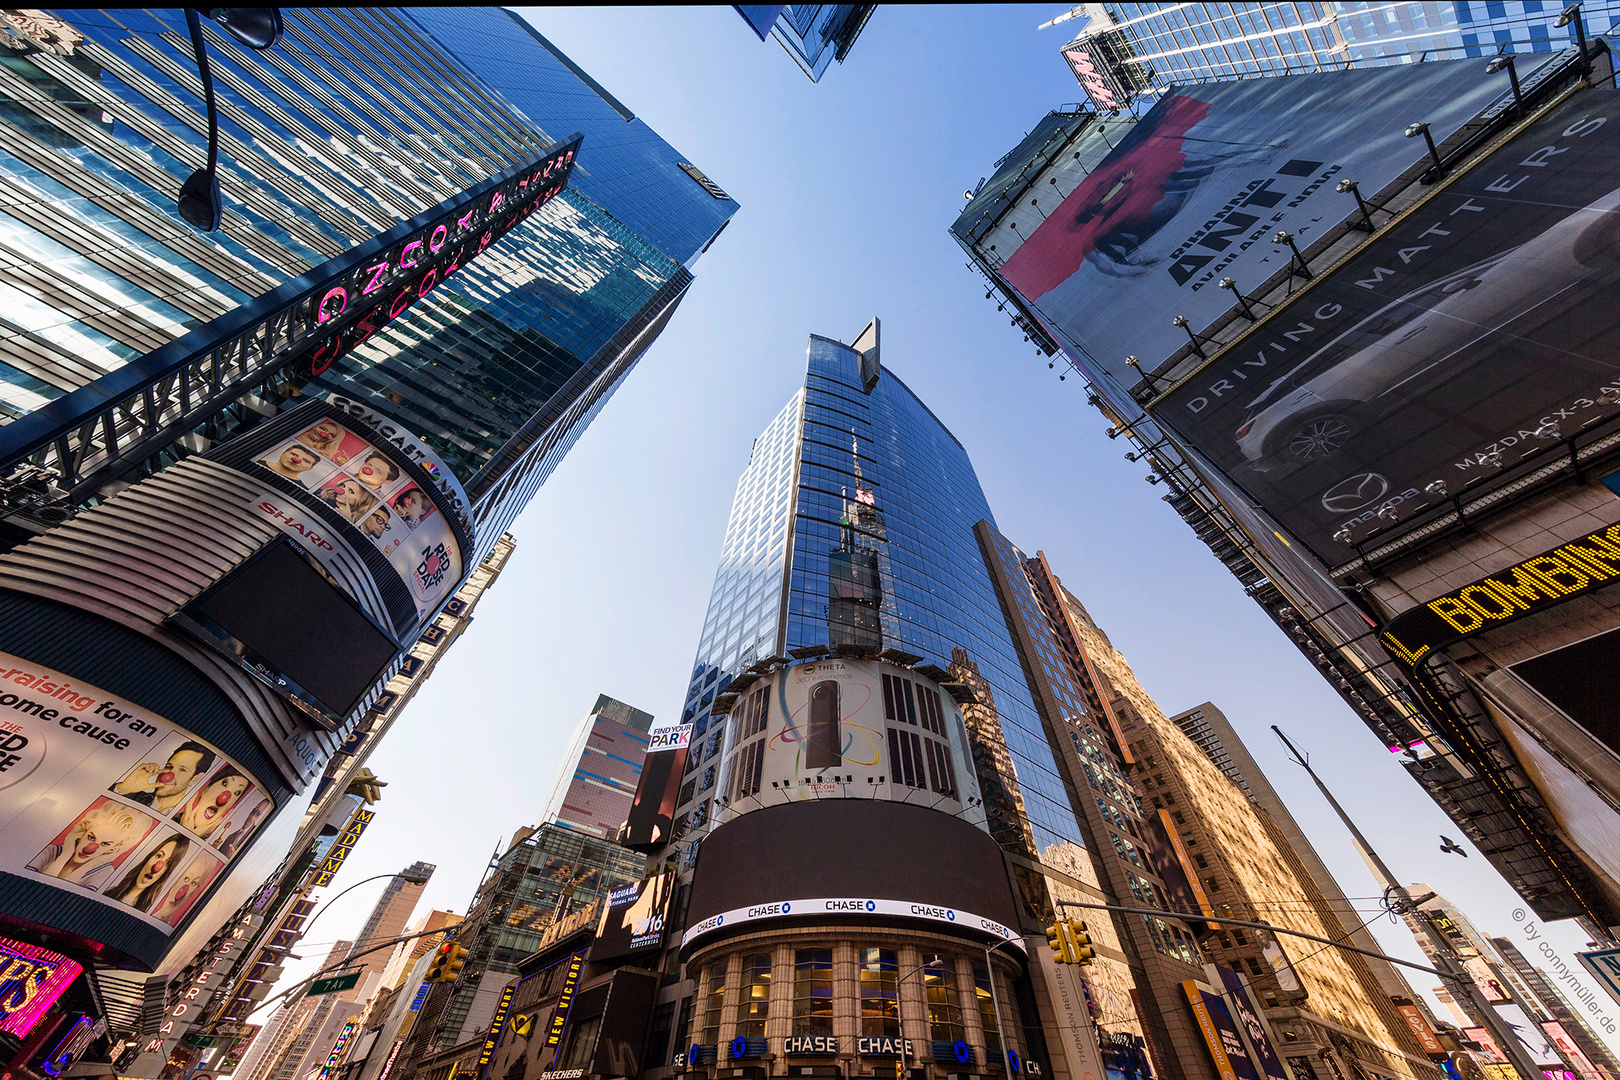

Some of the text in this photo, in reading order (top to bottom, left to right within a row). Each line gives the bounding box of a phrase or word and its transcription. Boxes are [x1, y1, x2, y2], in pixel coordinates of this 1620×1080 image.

[1167, 159, 1324, 287] ANTI
[1169, 178, 1264, 260] RIHANNA
[1191, 165, 1343, 292] AVAILABLE NOW
[1186, 114, 1608, 413] DRIVING MATTERS
[331, 396, 426, 463] COMCAST
[1455, 429, 1534, 471] MAZDA
[257, 501, 334, 553] SHARP
[434, 542, 451, 572] RED
[445, 545, 454, 557] THE
[413, 570, 426, 595] SPECIAL
[417, 560, 435, 590] DAY
[255, 662, 287, 688] SHARP
[818, 663, 846, 672] THETA
[0, 690, 131, 751] ome cause
[1, 721, 23, 734] THE
[94, 702, 133, 724] for
[129, 719, 157, 738] an
[653, 724, 691, 735] FIND YOUR
[288, 733, 317, 771] AQUOS
[650, 731, 690, 747] PARK
[317, 810, 375, 888] MADAME
[608, 886, 638, 900] SAGUARO
[825, 900, 864, 911] CHASE
[748, 903, 781, 918] CHASE
[911, 904, 946, 919] CHASE
[633, 914, 663, 936] 2016
[697, 916, 717, 934] CHASE
[980, 918, 1004, 935] CHASE
[144, 914, 252, 1052] AMSTERDAM
[323, 979, 332, 991] 7
[547, 954, 583, 1046] NEW VICTORY
[480, 985, 515, 1065] NEW VICTORY
[1056, 966, 1088, 1065] THOMSON REUTERS
[1192, 994, 1225, 1066] THOMSON REUTERS
[784, 1036, 838, 1053] CHASE
[858, 1037, 913, 1055] CHASE
[540, 1069, 584, 1080] SKECHERS
[1026, 1060, 1042, 1076] CH
